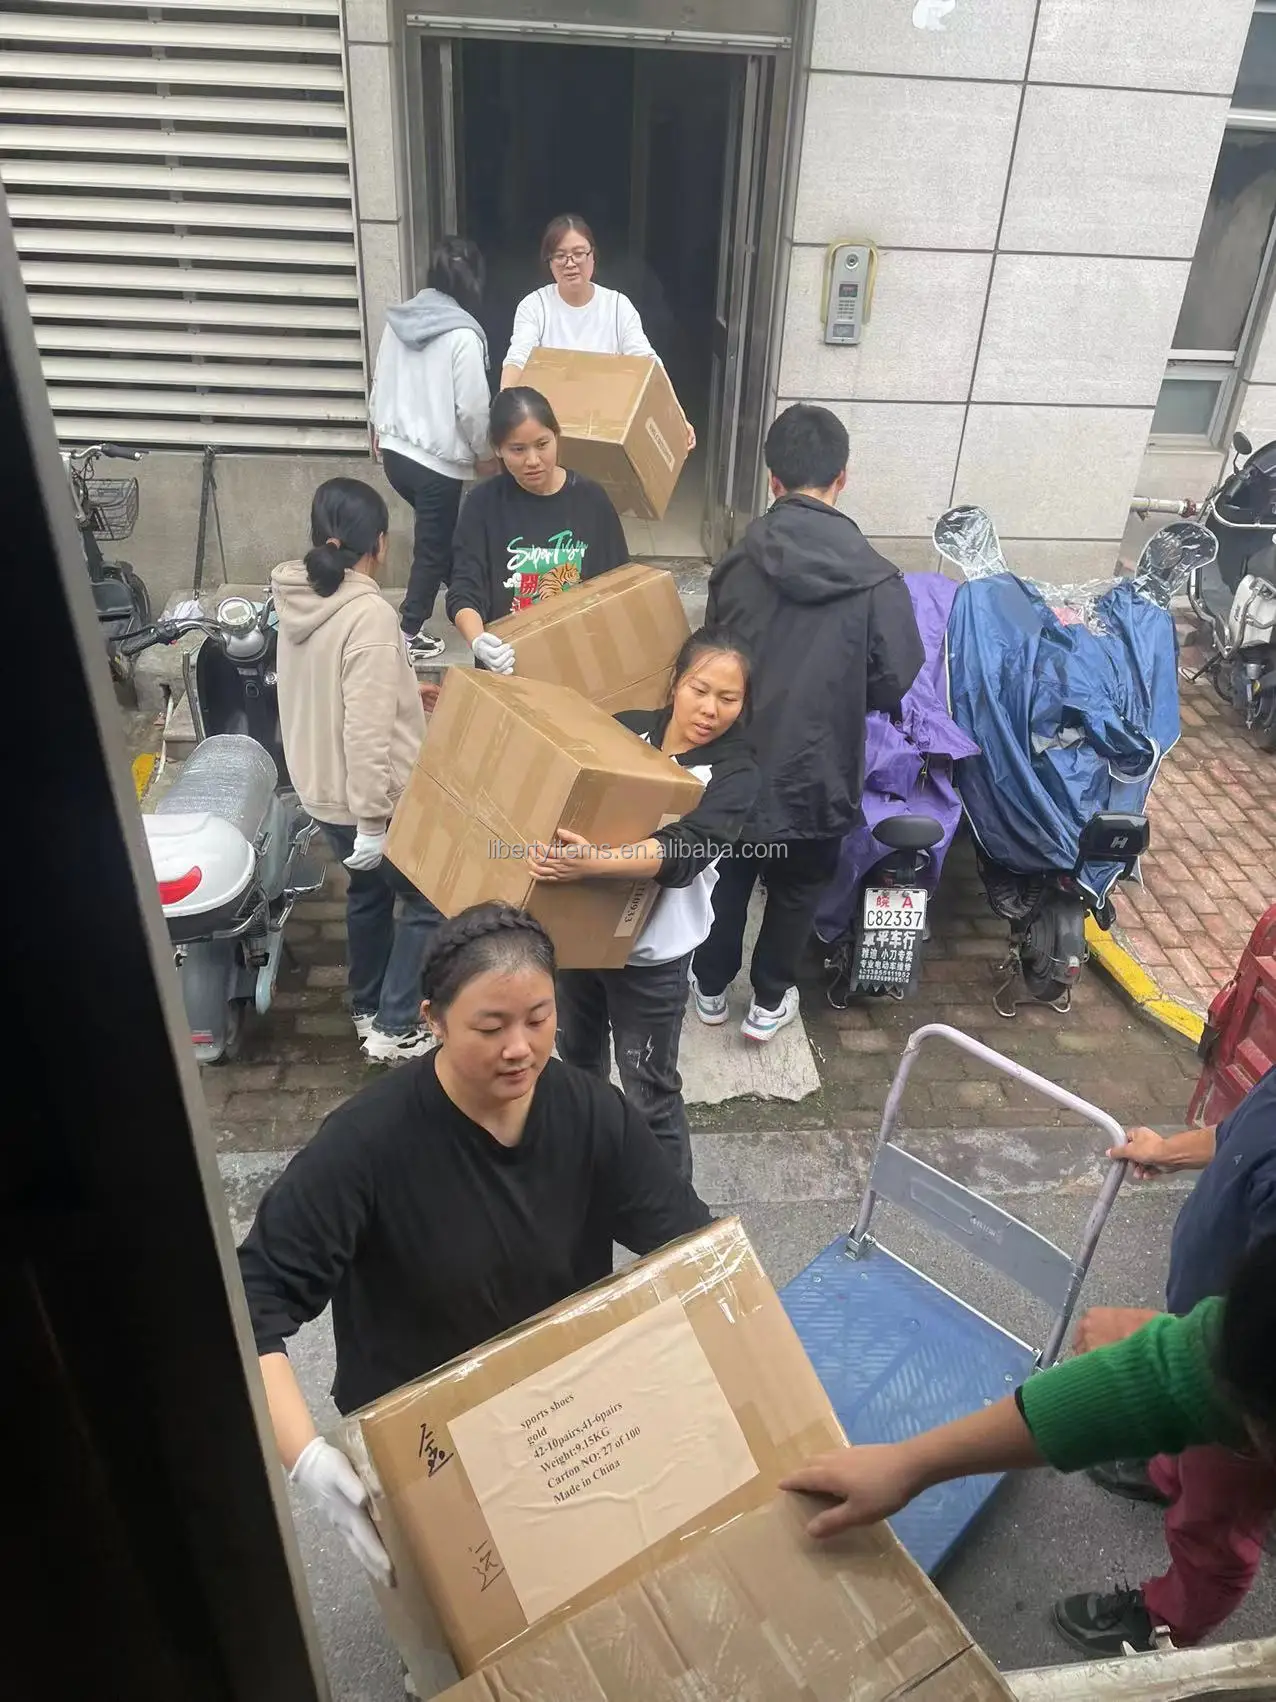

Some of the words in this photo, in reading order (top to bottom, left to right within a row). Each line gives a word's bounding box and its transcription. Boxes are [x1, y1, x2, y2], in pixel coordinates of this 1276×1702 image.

[867, 910, 923, 927] C82337
[902, 896, 914, 908] A
[520, 1408, 549, 1429] sports
[550, 1394, 575, 1412] shoes
[527, 1426, 548, 1446] gold
[540, 1426, 611, 1473] Weight:9.15KG
[547, 1465, 581, 1489] Carton
[602, 1442, 614, 1456] 27
[614, 1436, 625, 1448] of
[625, 1426, 641, 1442] 100
[553, 1483, 581, 1504] Made
[581, 1476, 592, 1488] in
[592, 1459, 621, 1480] China
